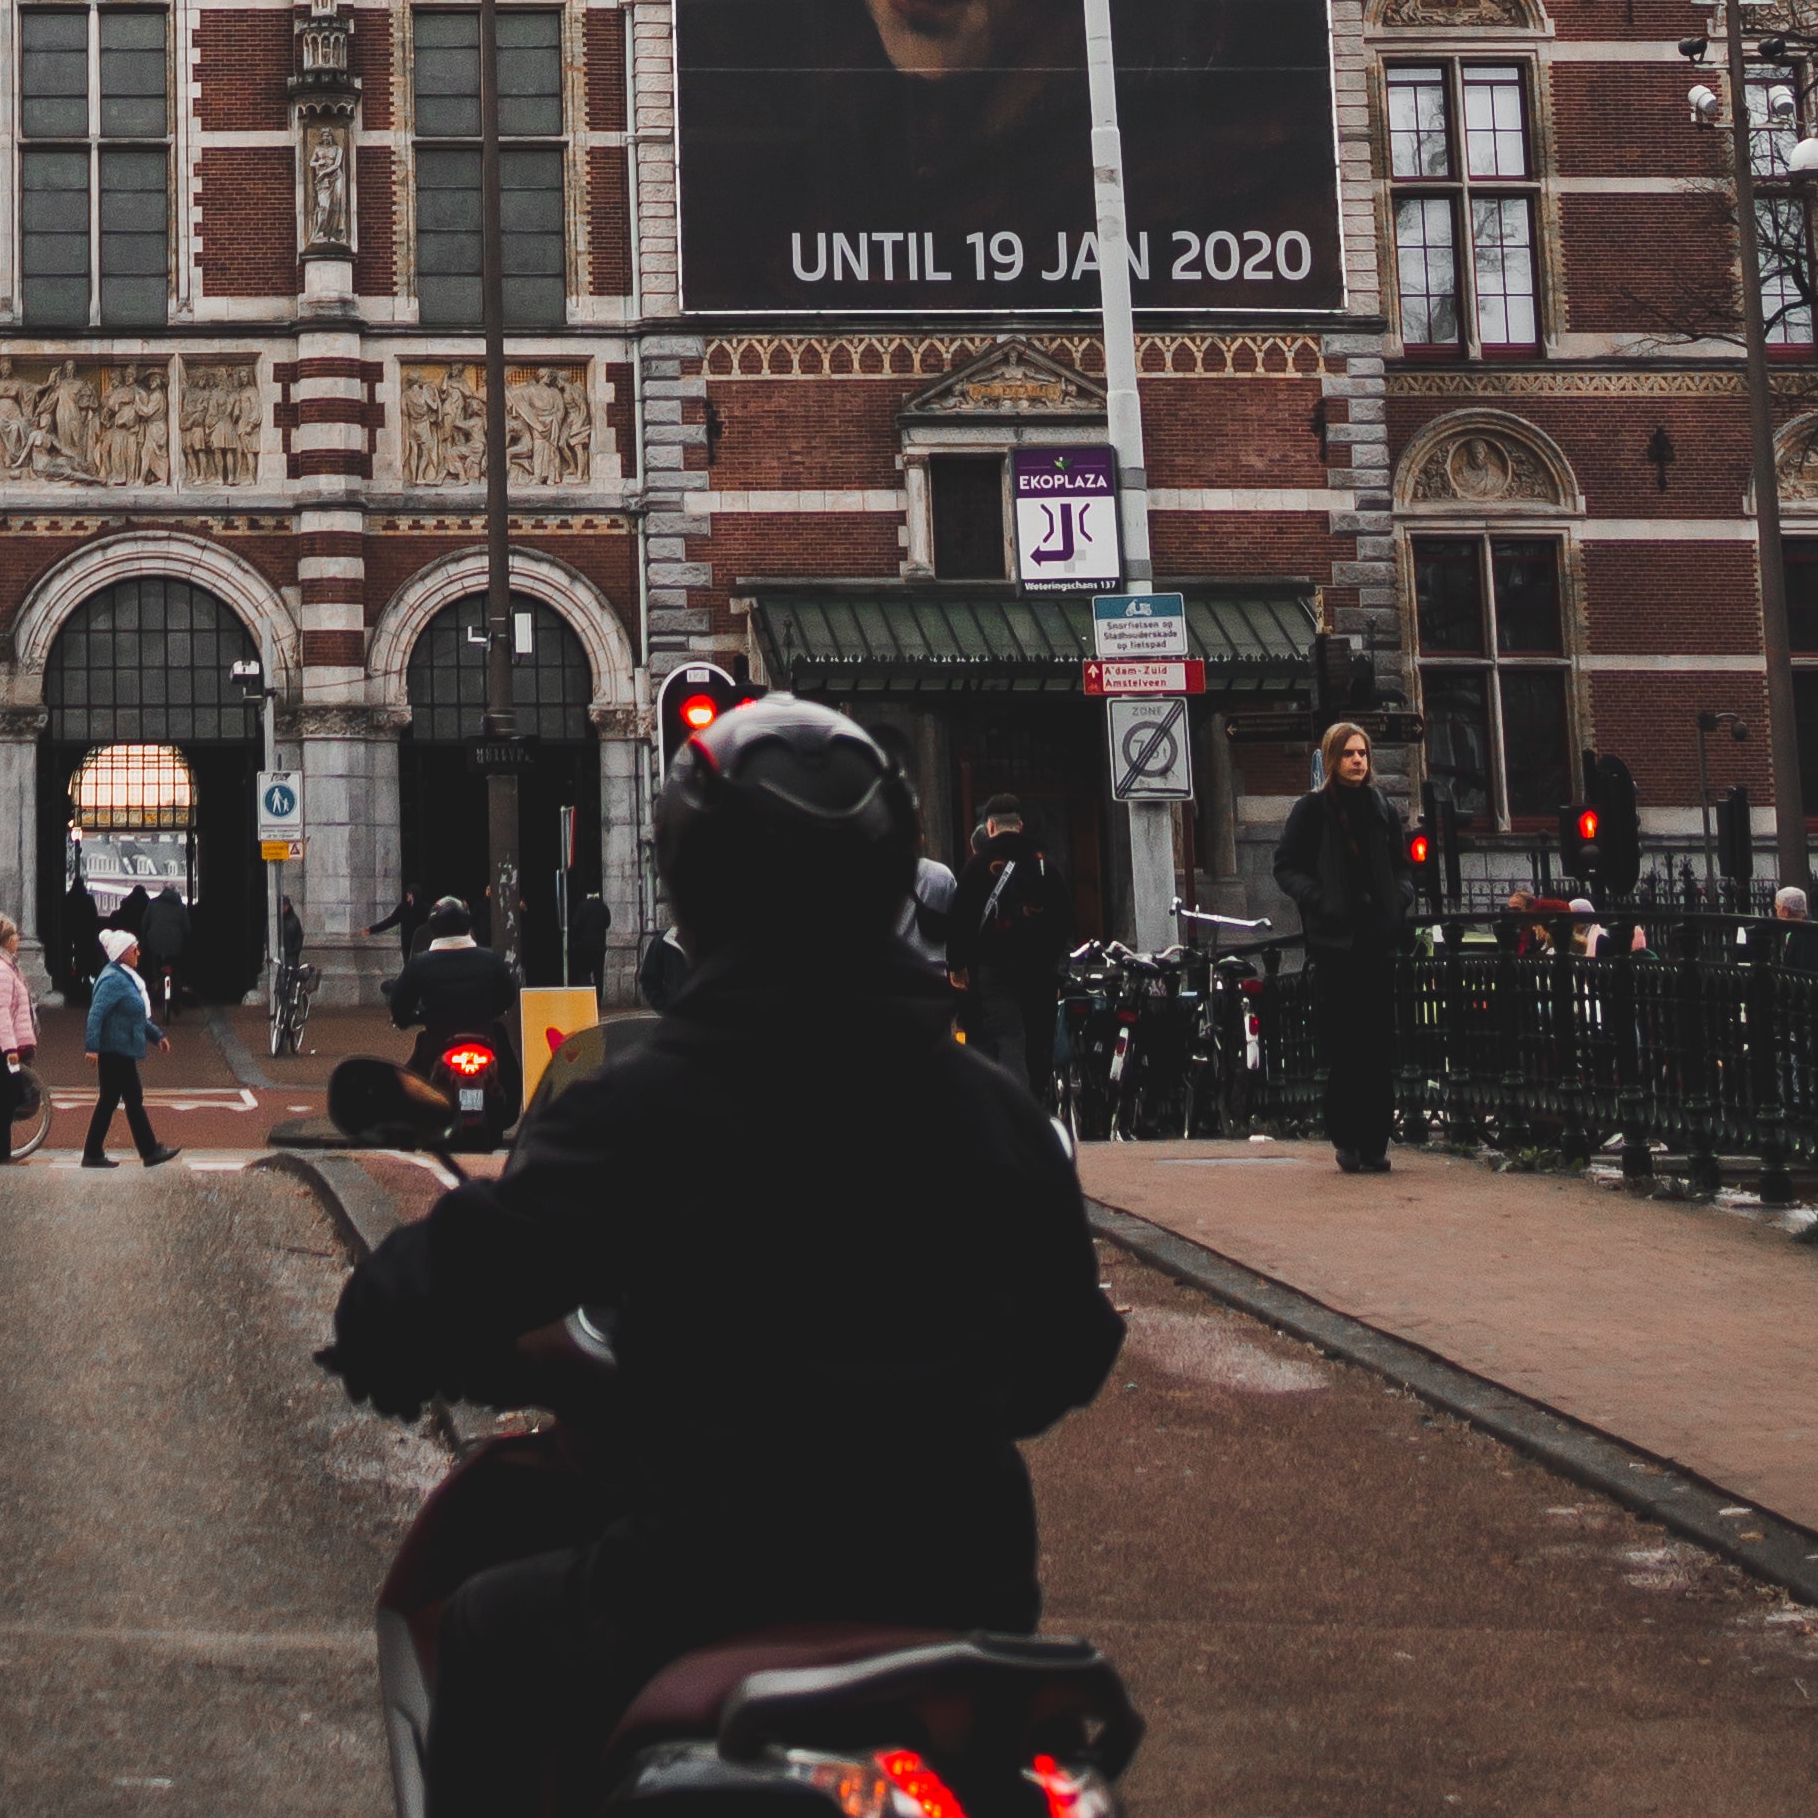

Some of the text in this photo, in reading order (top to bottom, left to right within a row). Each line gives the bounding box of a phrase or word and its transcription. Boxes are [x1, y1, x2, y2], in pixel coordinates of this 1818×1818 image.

[790, 231, 952, 282] UNTIL
[965, 231, 1024, 281] 19
[1172, 231, 1312, 281] 2020
[1019, 474, 1107, 490] EKOPLAZA
[1025, 581, 1098, 592] Weteringschans
[1105, 678, 1167, 688] Amstelveen
